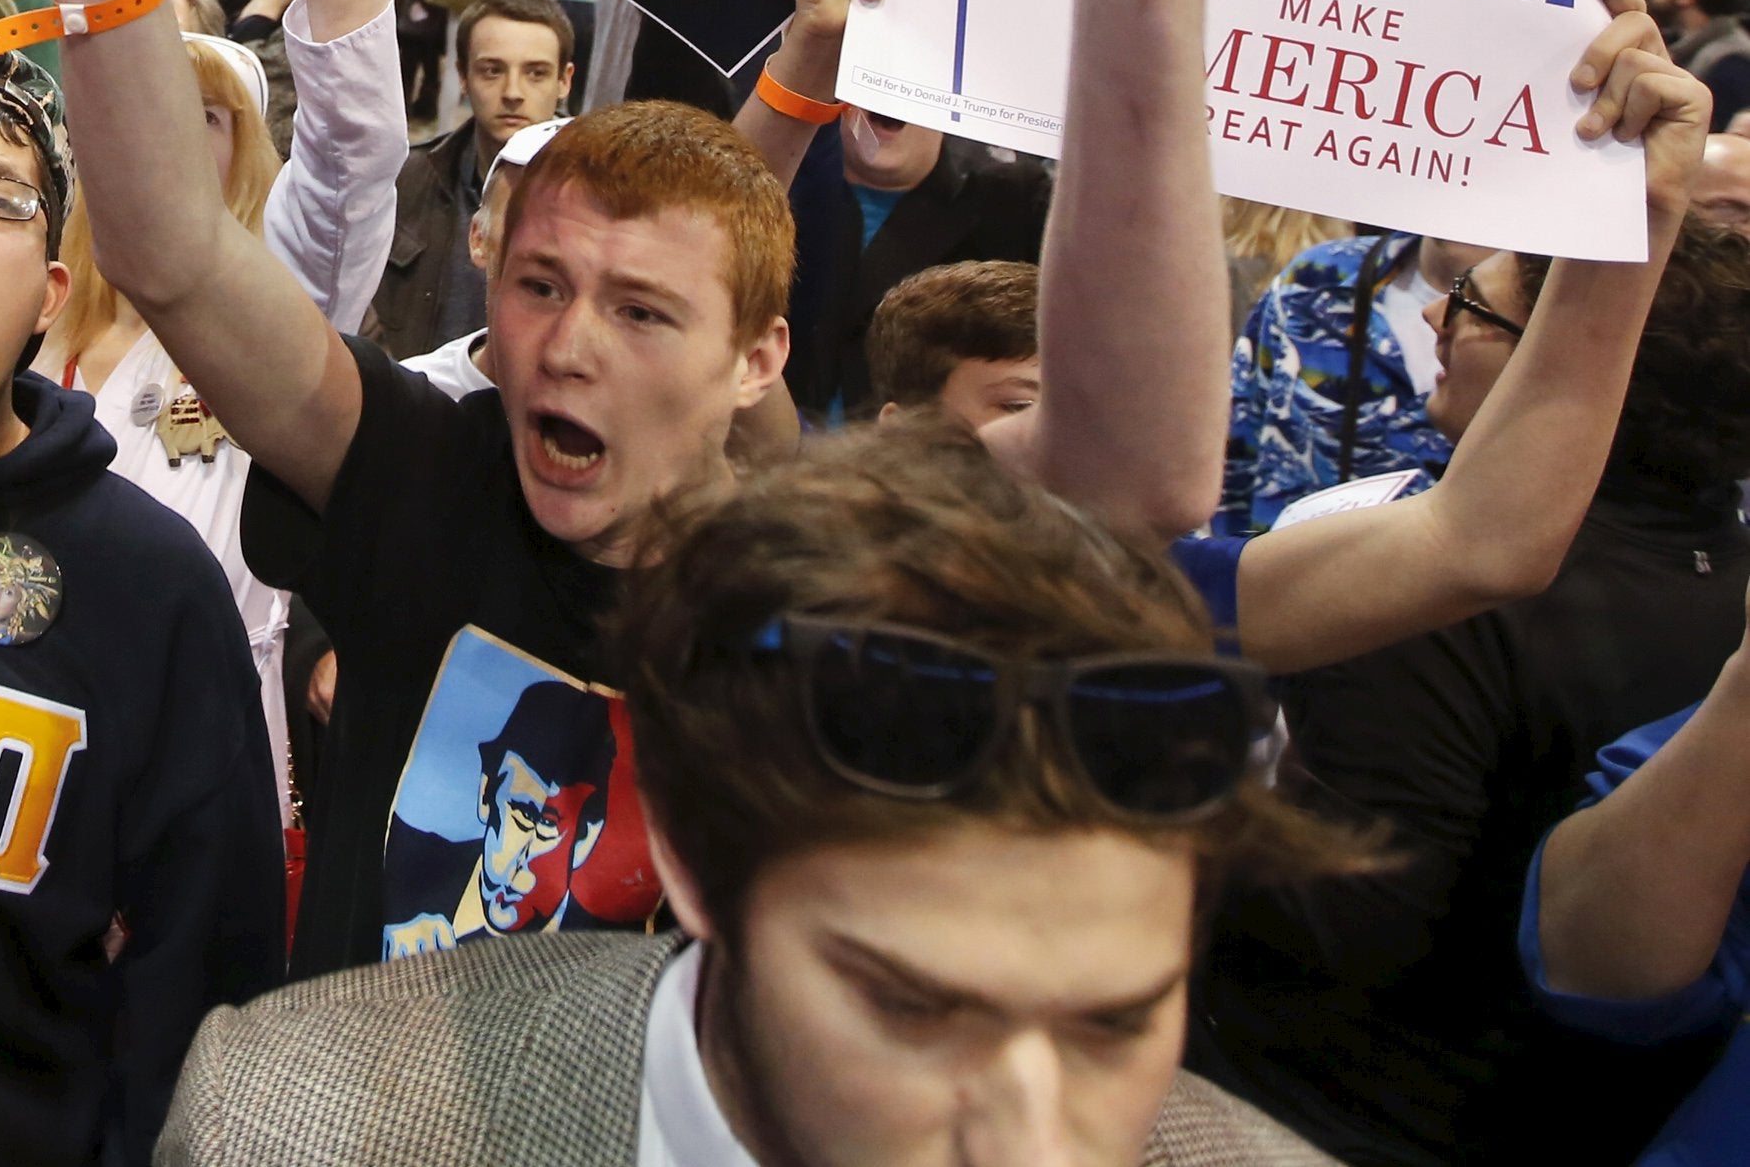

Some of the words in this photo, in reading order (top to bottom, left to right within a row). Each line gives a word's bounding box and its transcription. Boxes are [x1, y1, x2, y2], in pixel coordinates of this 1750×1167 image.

[861, 72, 882, 87] Paid
[883, 78, 899, 92] for
[900, 81, 913, 97] by
[914, 87, 951, 106] Donald
[952, 97, 960, 108] J.
[963, 99, 997, 117] Trump
[999, 106, 1016, 121] for
[1017, 112, 1064, 132] Presiden
[1204, 28, 1550, 155] MERICA
[1314, 129, 1472, 187] AGAIN!
